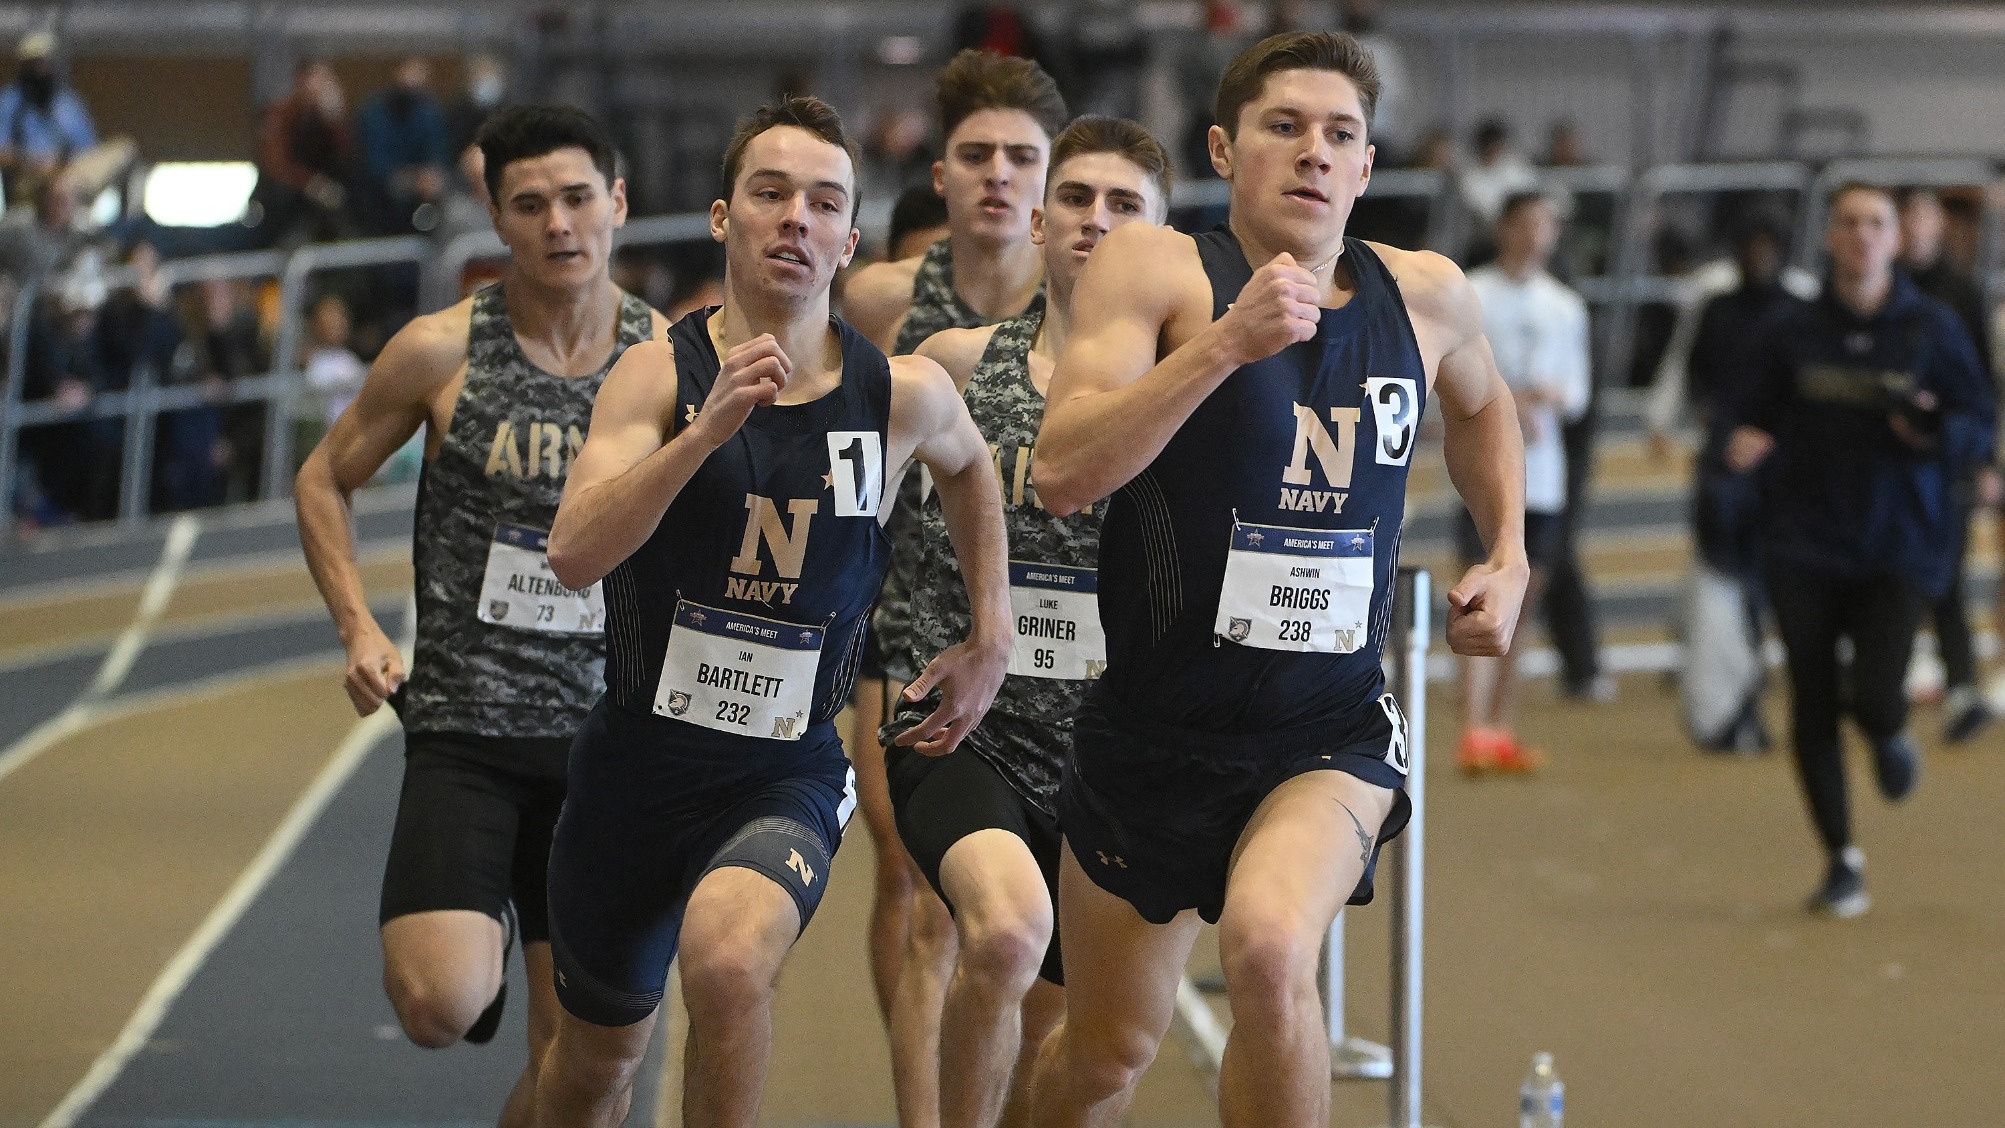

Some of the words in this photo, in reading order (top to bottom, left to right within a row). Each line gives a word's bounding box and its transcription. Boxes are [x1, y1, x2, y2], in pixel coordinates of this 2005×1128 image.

[1379, 382, 1411, 460] 3
[1282, 400, 1361, 489] N
[838, 437, 868, 512] 1
[1278, 487, 1349, 514] NAVY
[730, 492, 819, 579] N
[1283, 538, 1317, 550] AMERICA'S
[1318, 540, 1335, 550] MEET
[1026, 571, 1058, 583] AMERICA'S
[1059, 575, 1076, 585] MEET
[1290, 566, 1321, 579] ASHWIN
[724, 576, 799, 605] NAVY
[1269, 584, 1331, 611] BRIGGS
[537, 604, 555, 622] 73
[1040, 598, 1059, 610] LUKE
[726, 621, 760, 637] AMERICA'S
[760, 628, 779, 640] MEET
[1018, 615, 1076, 641] GRINER
[1278, 619, 1312, 642] 238
[1334, 629, 1356, 652] N
[738, 650, 753, 663] IAN
[1033, 648, 1055, 670] 95
[696, 662, 784, 699] BARTLETT
[715, 700, 751, 726] 232
[771, 717, 796, 739] N
[785, 847, 815, 887] N
